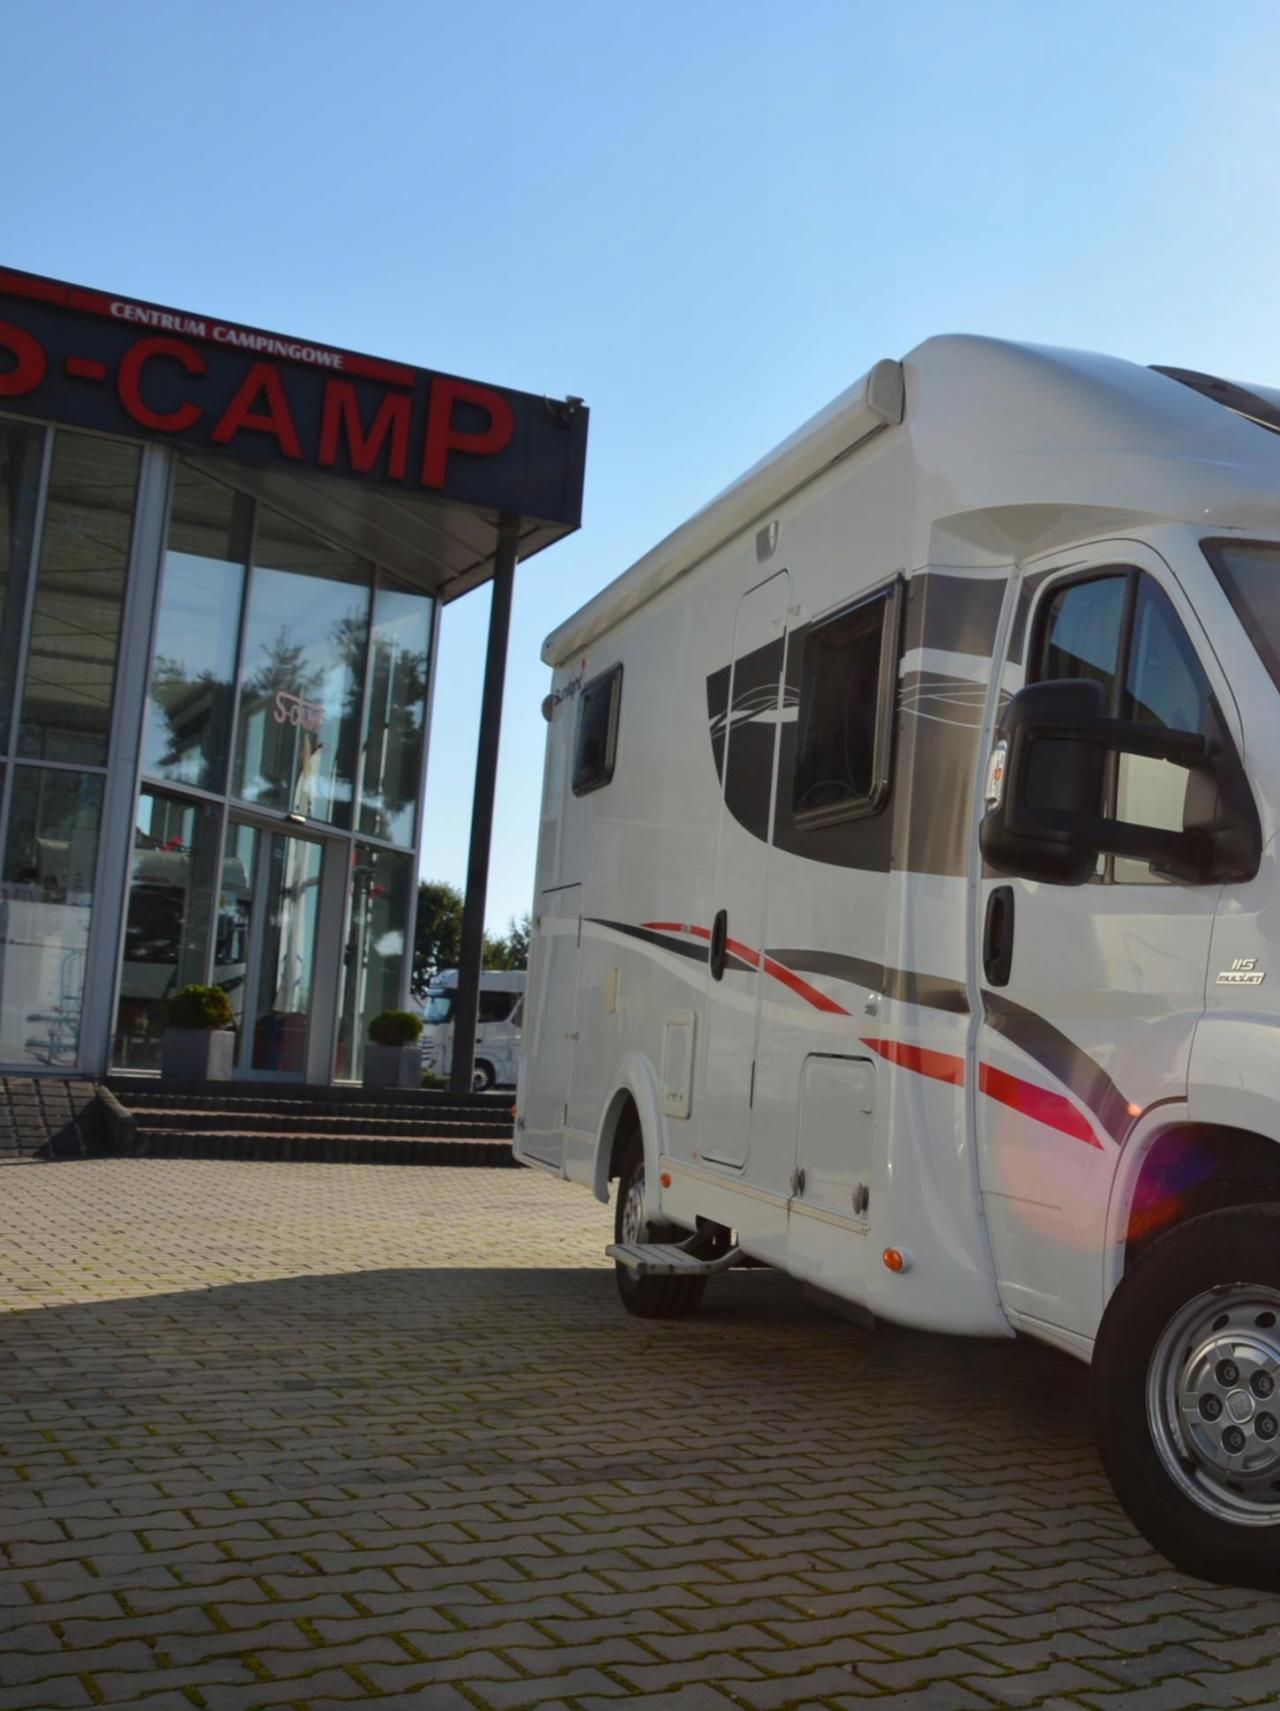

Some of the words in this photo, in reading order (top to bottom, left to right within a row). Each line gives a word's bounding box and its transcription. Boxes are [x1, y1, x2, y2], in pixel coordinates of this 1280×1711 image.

[110, 301, 207, 338] CENTRUM
[212, 326, 344, 370] CAMPINGOWE
[1231, 958, 1257, 971] 115
